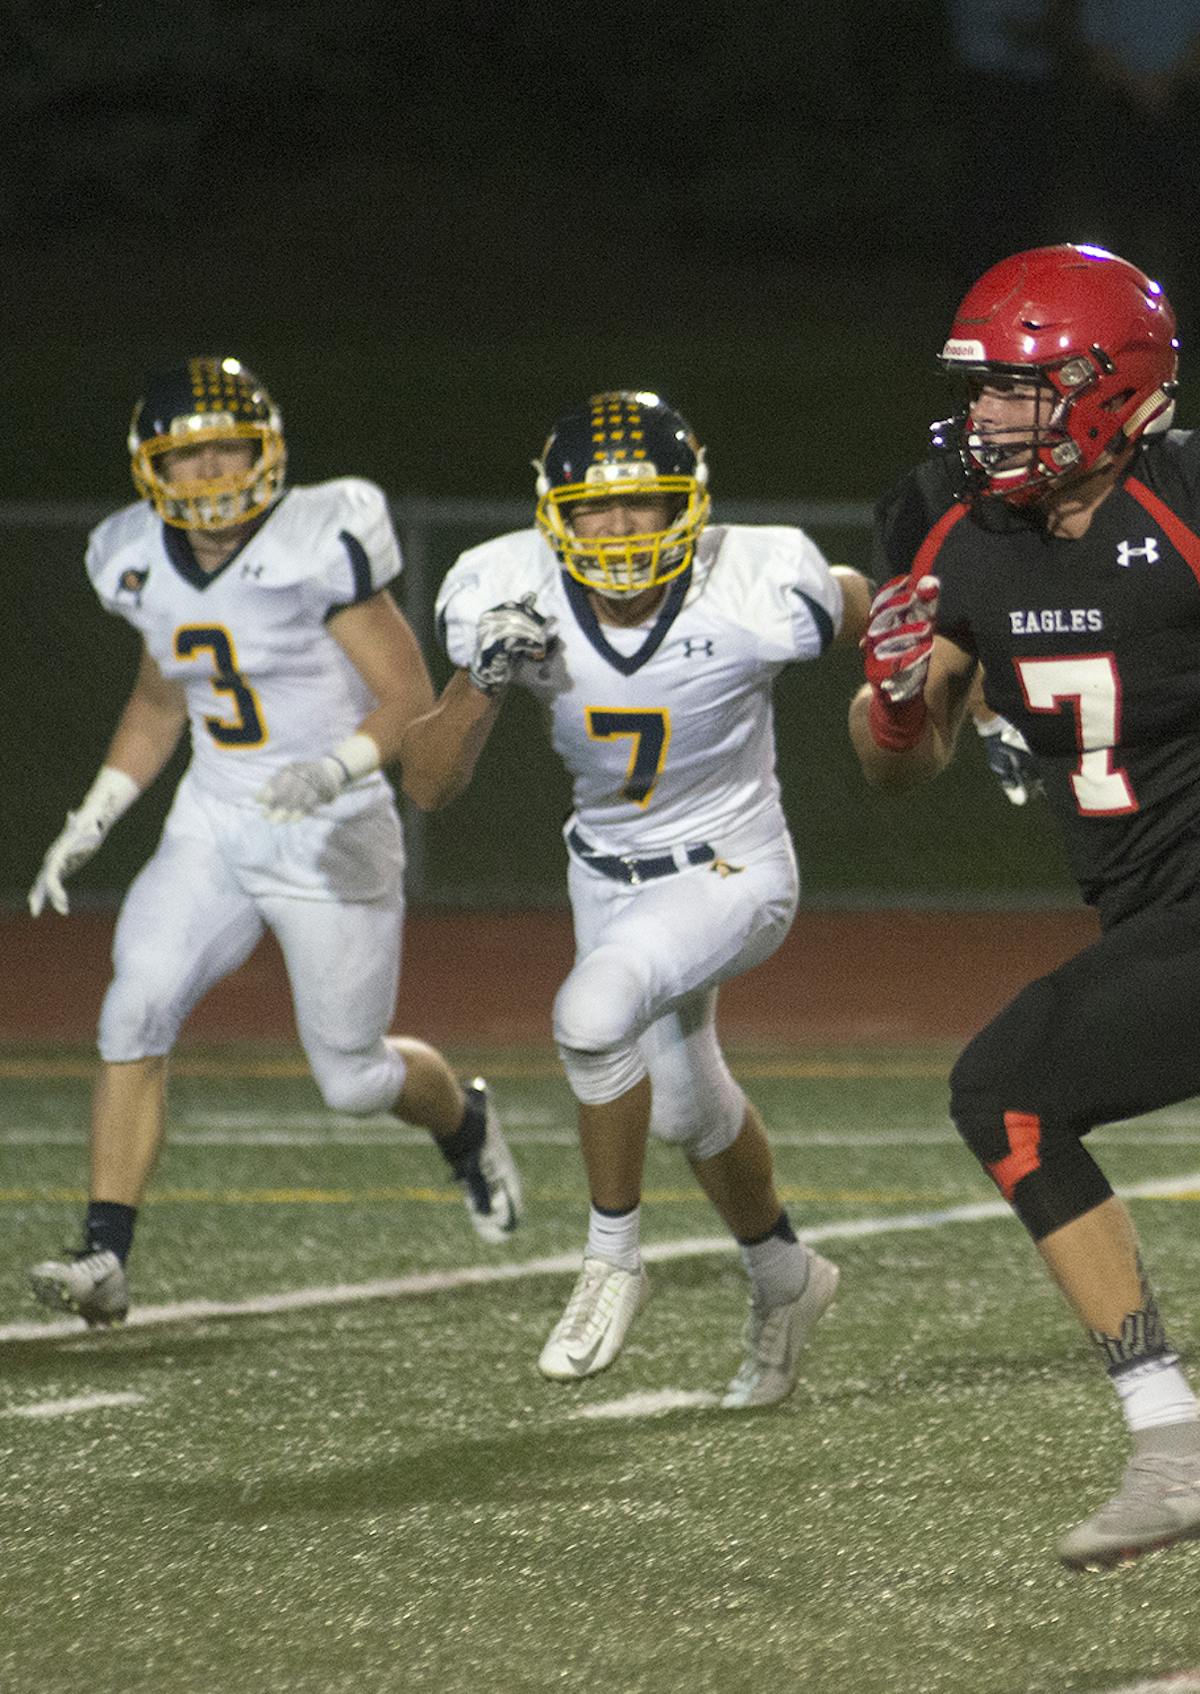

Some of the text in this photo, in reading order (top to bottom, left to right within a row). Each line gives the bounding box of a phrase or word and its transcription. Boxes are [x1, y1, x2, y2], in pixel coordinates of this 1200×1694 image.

[1009, 609, 1102, 634] EAGLES
[173, 623, 269, 750] 3
[1012, 651, 1141, 816] 7
[583, 705, 671, 811] 7
